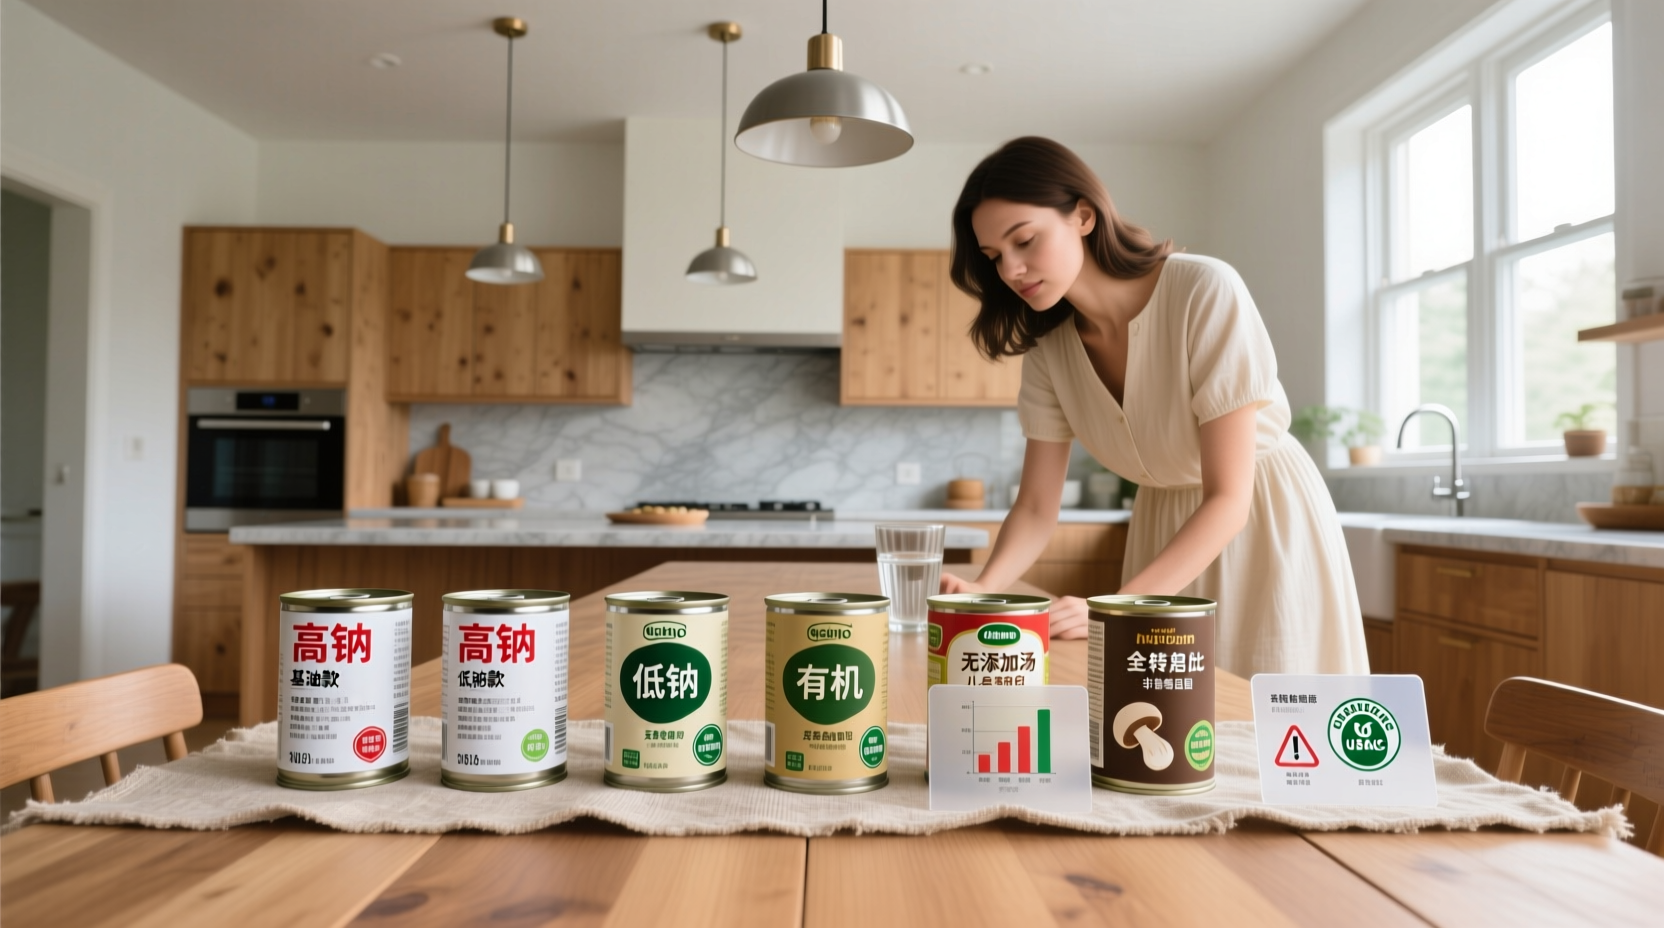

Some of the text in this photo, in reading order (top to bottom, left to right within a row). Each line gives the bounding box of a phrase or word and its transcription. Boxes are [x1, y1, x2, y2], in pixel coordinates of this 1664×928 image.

[293, 622, 372, 664] 高钠
[458, 622, 535, 664] 高钠
[961, 651, 1036, 673] 无添加汤
[632, 662, 698, 699] 低钠
[796, 663, 864, 701] 有机
